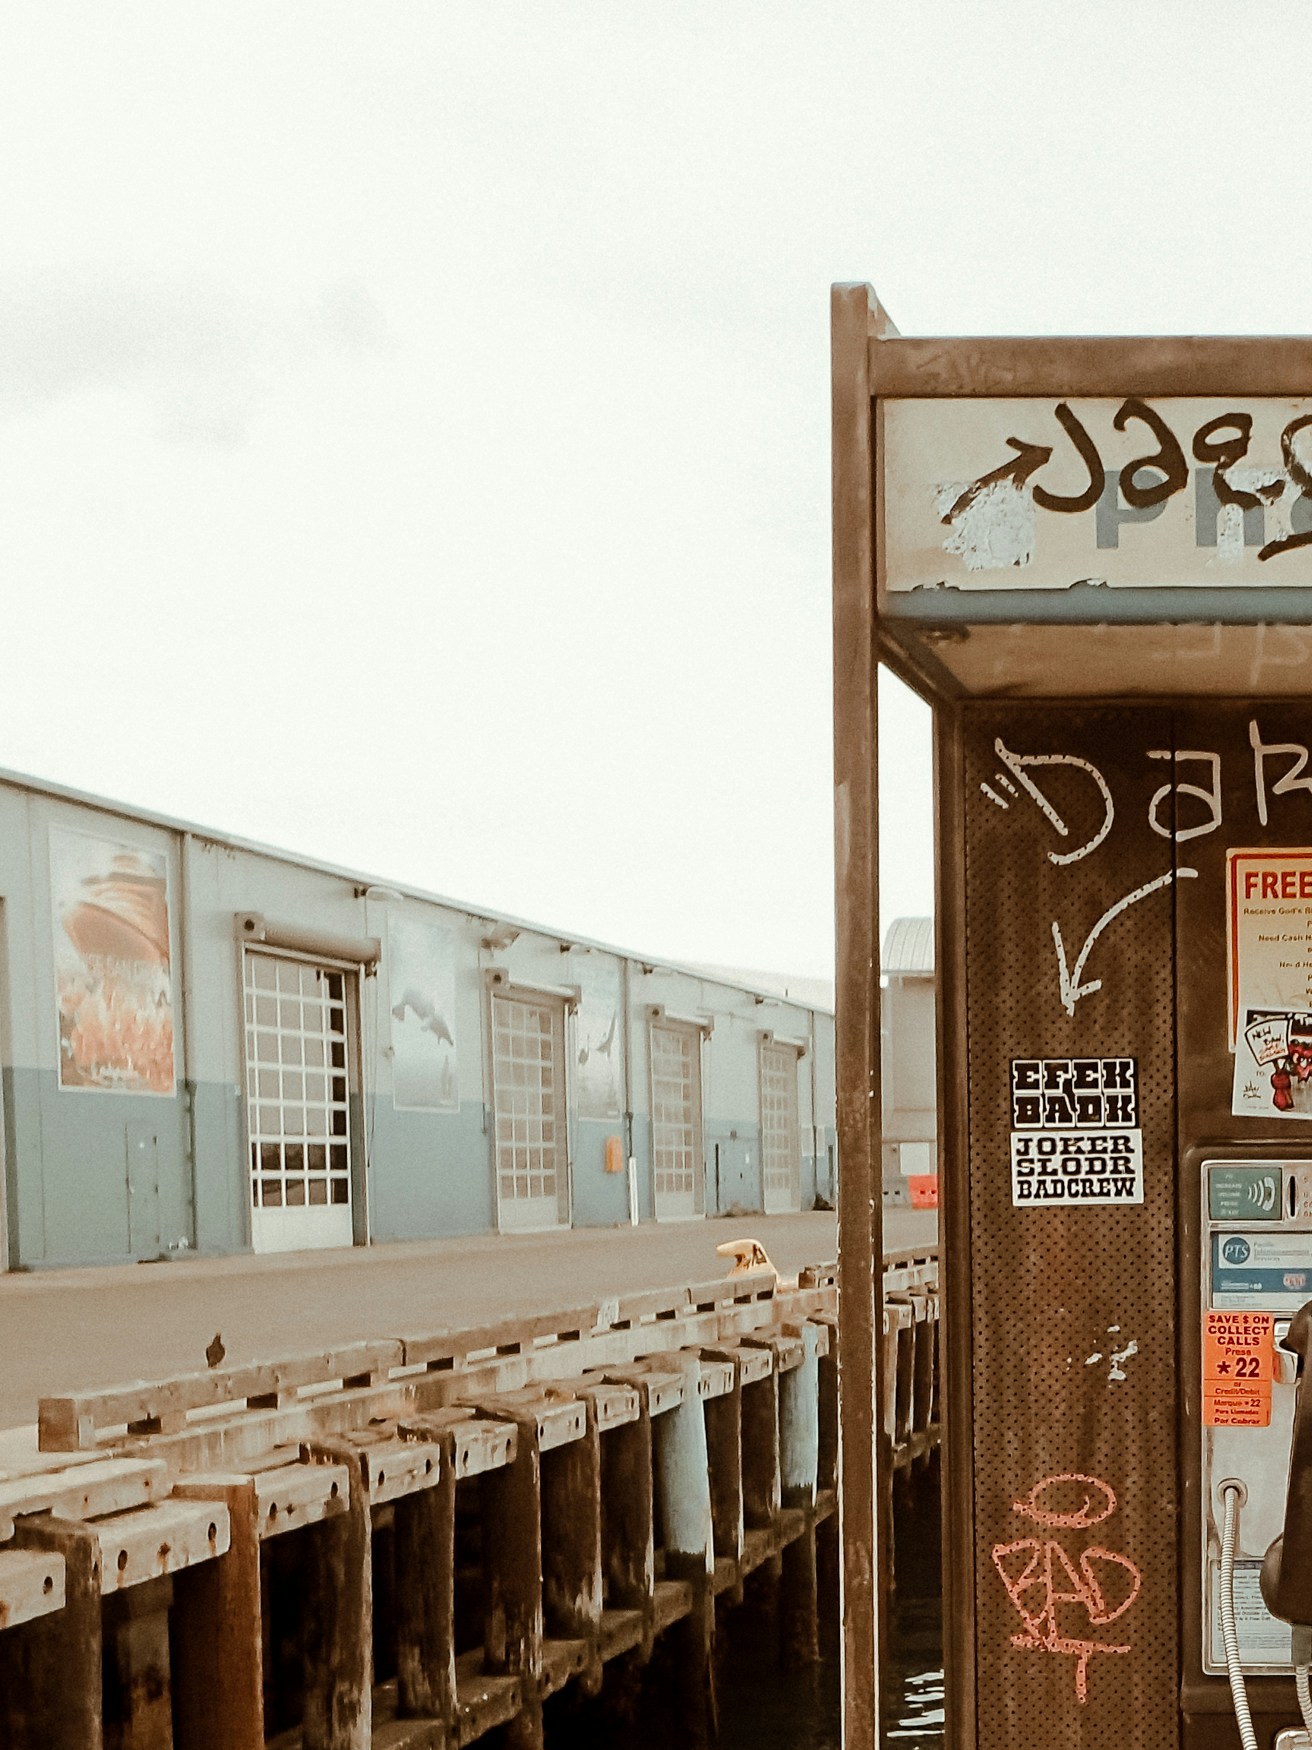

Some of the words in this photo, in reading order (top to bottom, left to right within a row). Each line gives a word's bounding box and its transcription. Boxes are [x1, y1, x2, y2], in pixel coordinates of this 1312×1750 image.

[1012, 1059, 1134, 1094] EFEK
[1016, 1135, 1136, 1156] JOKER
[1016, 1156, 1136, 1177] SLODR
[1017, 1177, 1136, 1200] BADCREW
[1225, 1244, 1249, 1259] PTS
[1209, 1315, 1240, 1324] SAVE
[1242, 1314, 1250, 1325] $
[1252, 1316, 1270, 1324] ON
[1208, 1325, 1270, 1336] COLLECT
[1217, 1336, 1260, 1346] CALLS
[1225, 1347, 1252, 1356] Press
[1231, 1417, 1261, 1425] Cobrar
